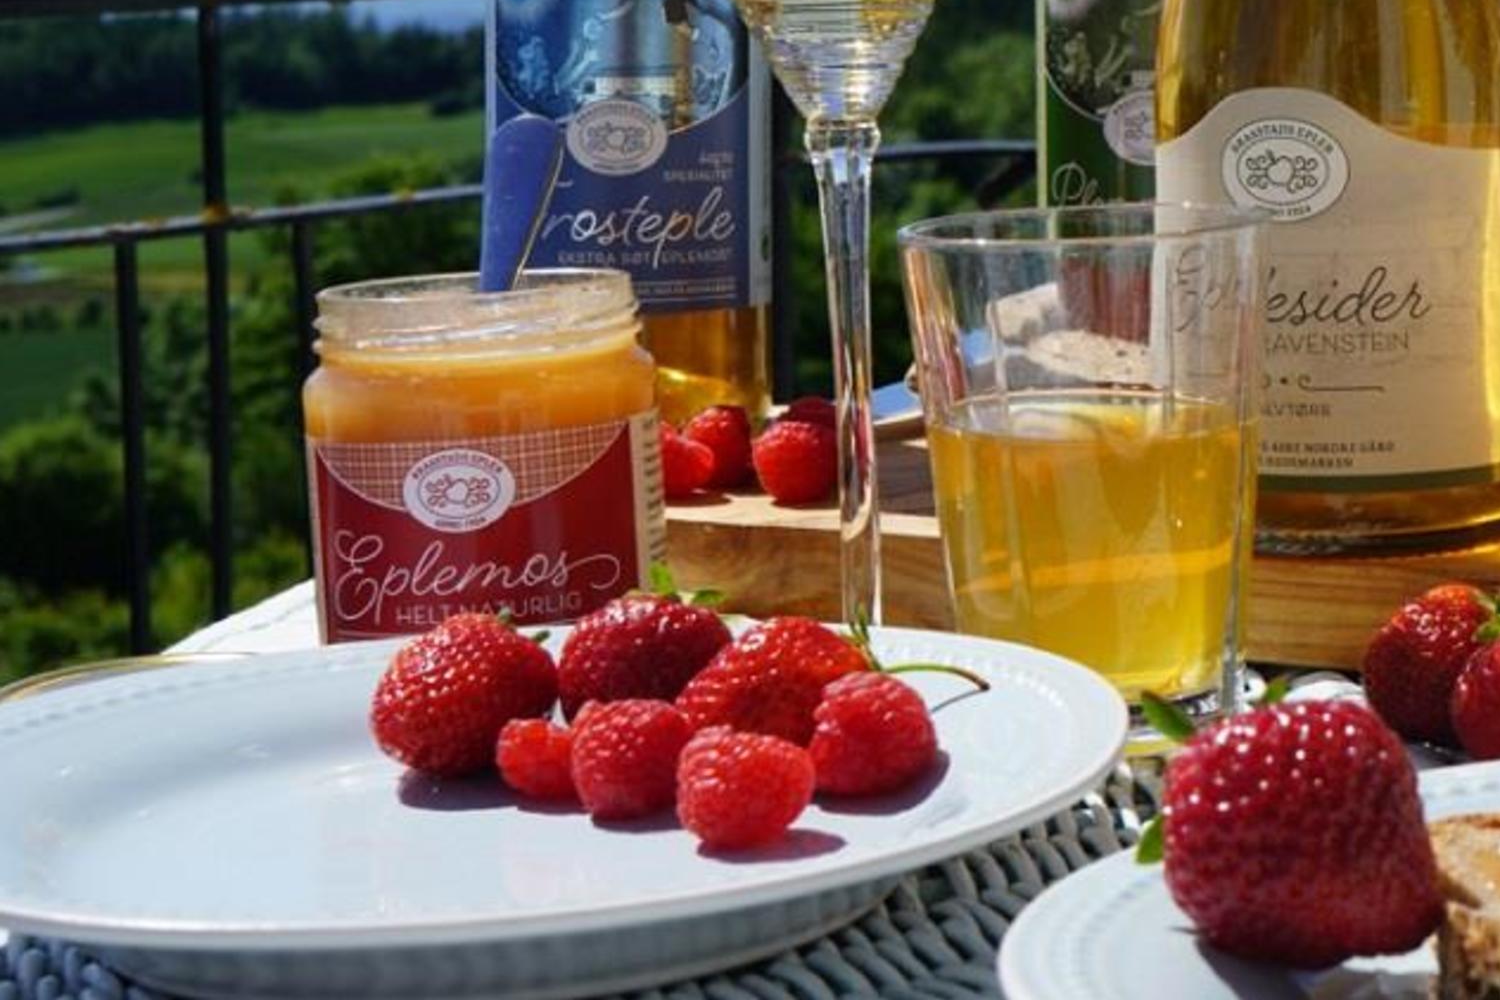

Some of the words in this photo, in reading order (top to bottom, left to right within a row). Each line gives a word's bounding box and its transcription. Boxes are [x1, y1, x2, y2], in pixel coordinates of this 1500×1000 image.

[540, 185, 737, 269] rosteple
[1263, 328, 1411, 355] AVENSTEIN
[333, 530, 621, 625] Eplemos
[395, 602, 452, 626] HELT
